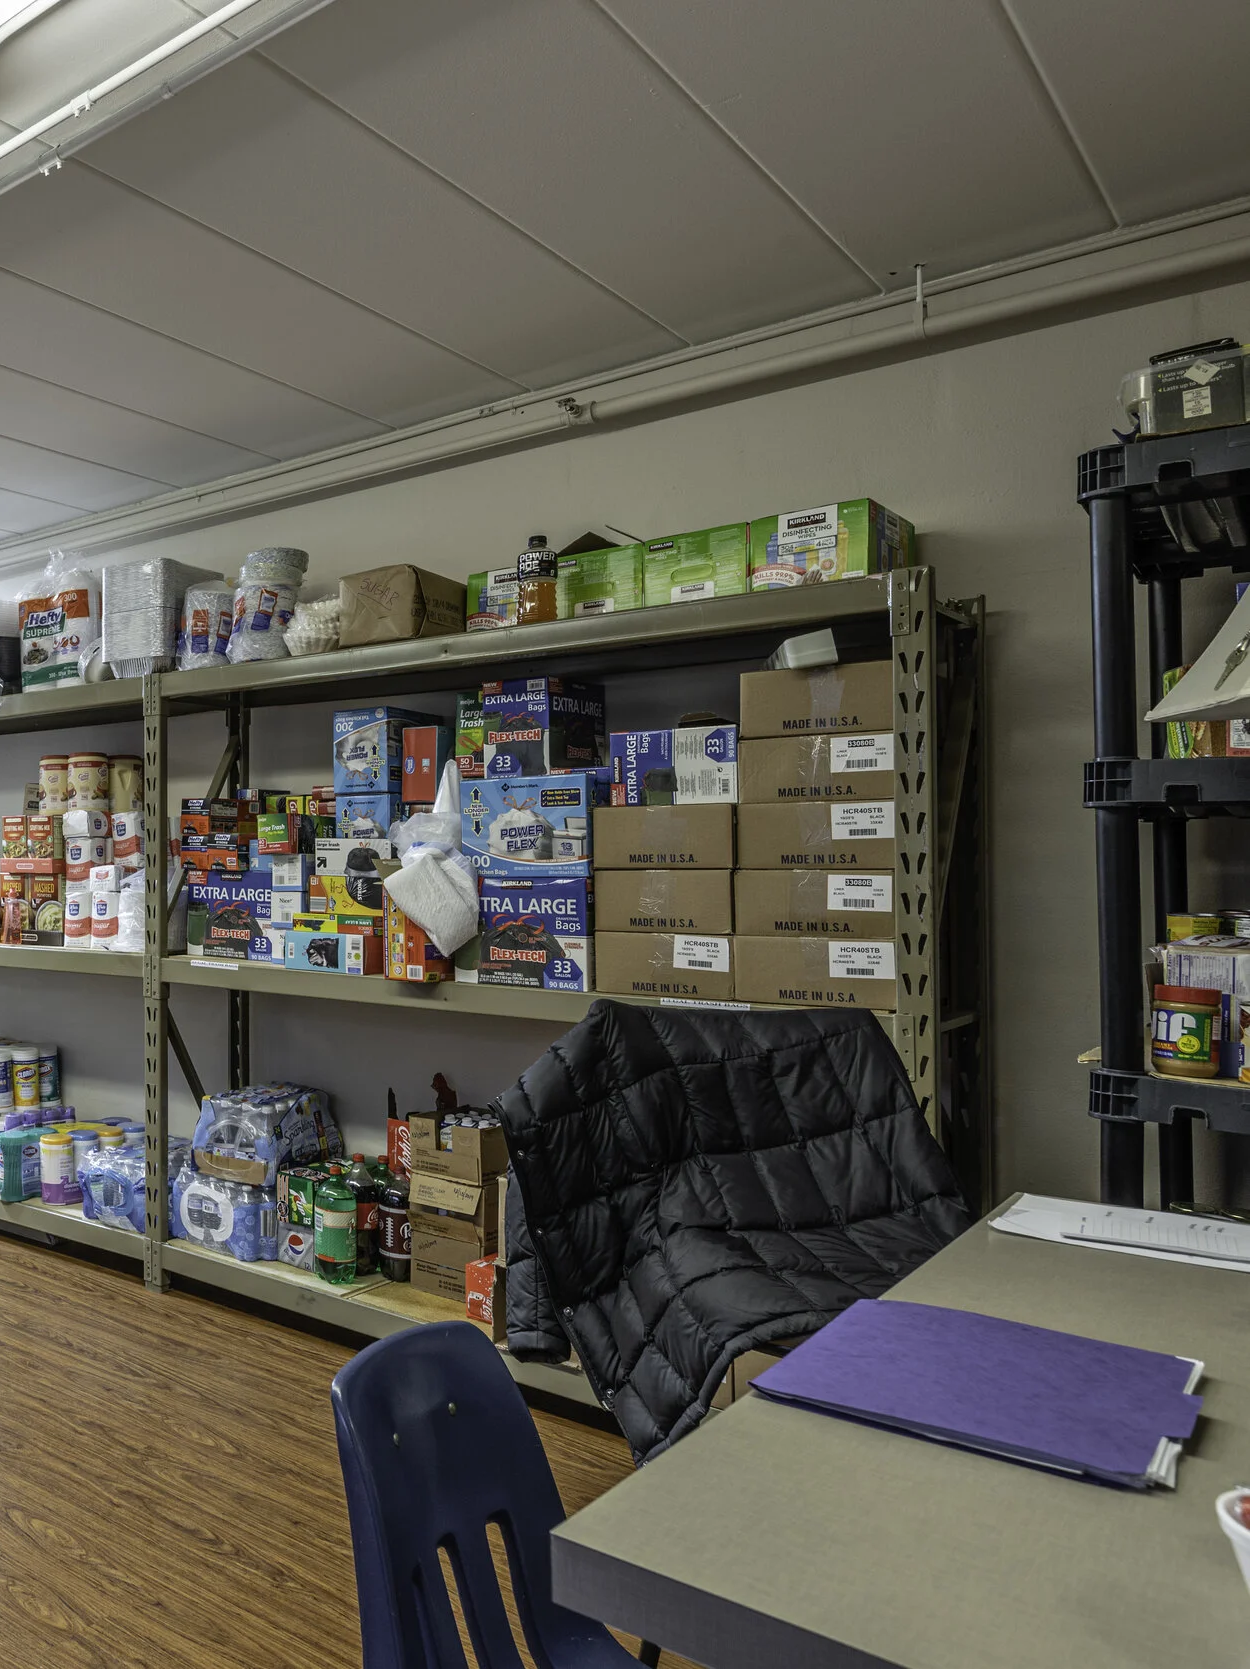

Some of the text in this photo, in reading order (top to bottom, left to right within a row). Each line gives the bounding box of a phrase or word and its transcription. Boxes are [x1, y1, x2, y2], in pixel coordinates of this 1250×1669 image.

[789, 514, 826, 526] KIRKLAND
[782, 524, 833, 538] DISINFECTING
[650, 541, 674, 550] KIRKLAND
[519, 551, 555, 563] POWER
[519, 560, 540, 572] ADE
[754, 571, 795, 581] KILLS 99.9%
[63, 592, 77, 602] 300
[359, 578, 400, 607] SUGAR
[29, 611, 61, 626] Hefty
[25, 624, 61, 638] SUPREME
[485, 691, 546, 705] EXTRA LARGE
[528, 704, 547, 712] Bags
[552, 696, 603, 718] EXTRA LARGE
[460, 709, 484, 719] Large
[335, 721, 354, 733] 200
[460, 719, 484, 728] Trash
[782, 715, 863, 730] MADE IN U.S.A.
[488, 728, 543, 745] FLEX-TECH
[641, 732, 651, 754] Bags
[707, 738, 720, 754] 33
[848, 739, 875, 748] 33080B
[346, 752, 369, 761] POWER
[728, 750, 735, 758] 90
[495, 755, 511, 768] 33
[627, 734, 638, 804] EXTRA LARGE
[778, 785, 857, 798] MADE IN U.S.A.
[843, 807, 883, 815] HCR40STB
[352, 829, 375, 837] POWER
[500, 825, 546, 840] POWER
[506, 838, 540, 852] FLEX
[560, 842, 573, 852] 13
[629, 853, 698, 864] MADE IN U.S.A.
[780, 853, 858, 865] MADE IN U.S.A
[34, 883, 55, 893] MASHED
[845, 878, 873, 887] 33080B
[193, 886, 271, 902] EXTRA LARGE
[256, 905, 271, 916] Bag
[480, 897, 577, 915] TRA LARGE
[555, 920, 581, 933] Bags
[629, 917, 698, 928] MADE IN U.S.A.
[774, 920, 854, 933] MADE IN U.S.A.
[211, 926, 251, 941] FLEX-TECH
[254, 937, 267, 949] 33
[684, 940, 719, 948] HCR40STB
[490, 946, 547, 964] FLEX-TECH
[840, 946, 881, 954] HCR40STB
[553, 960, 572, 974] 33
[558, 982, 579, 990] BAGS
[632, 981, 698, 995] MADE IN U.S.A
[779, 989, 856, 1003] MADE IN U.S.A
[17, 1070, 35, 1079] CLOROX
[284, 1118, 316, 1147] Sparkling
